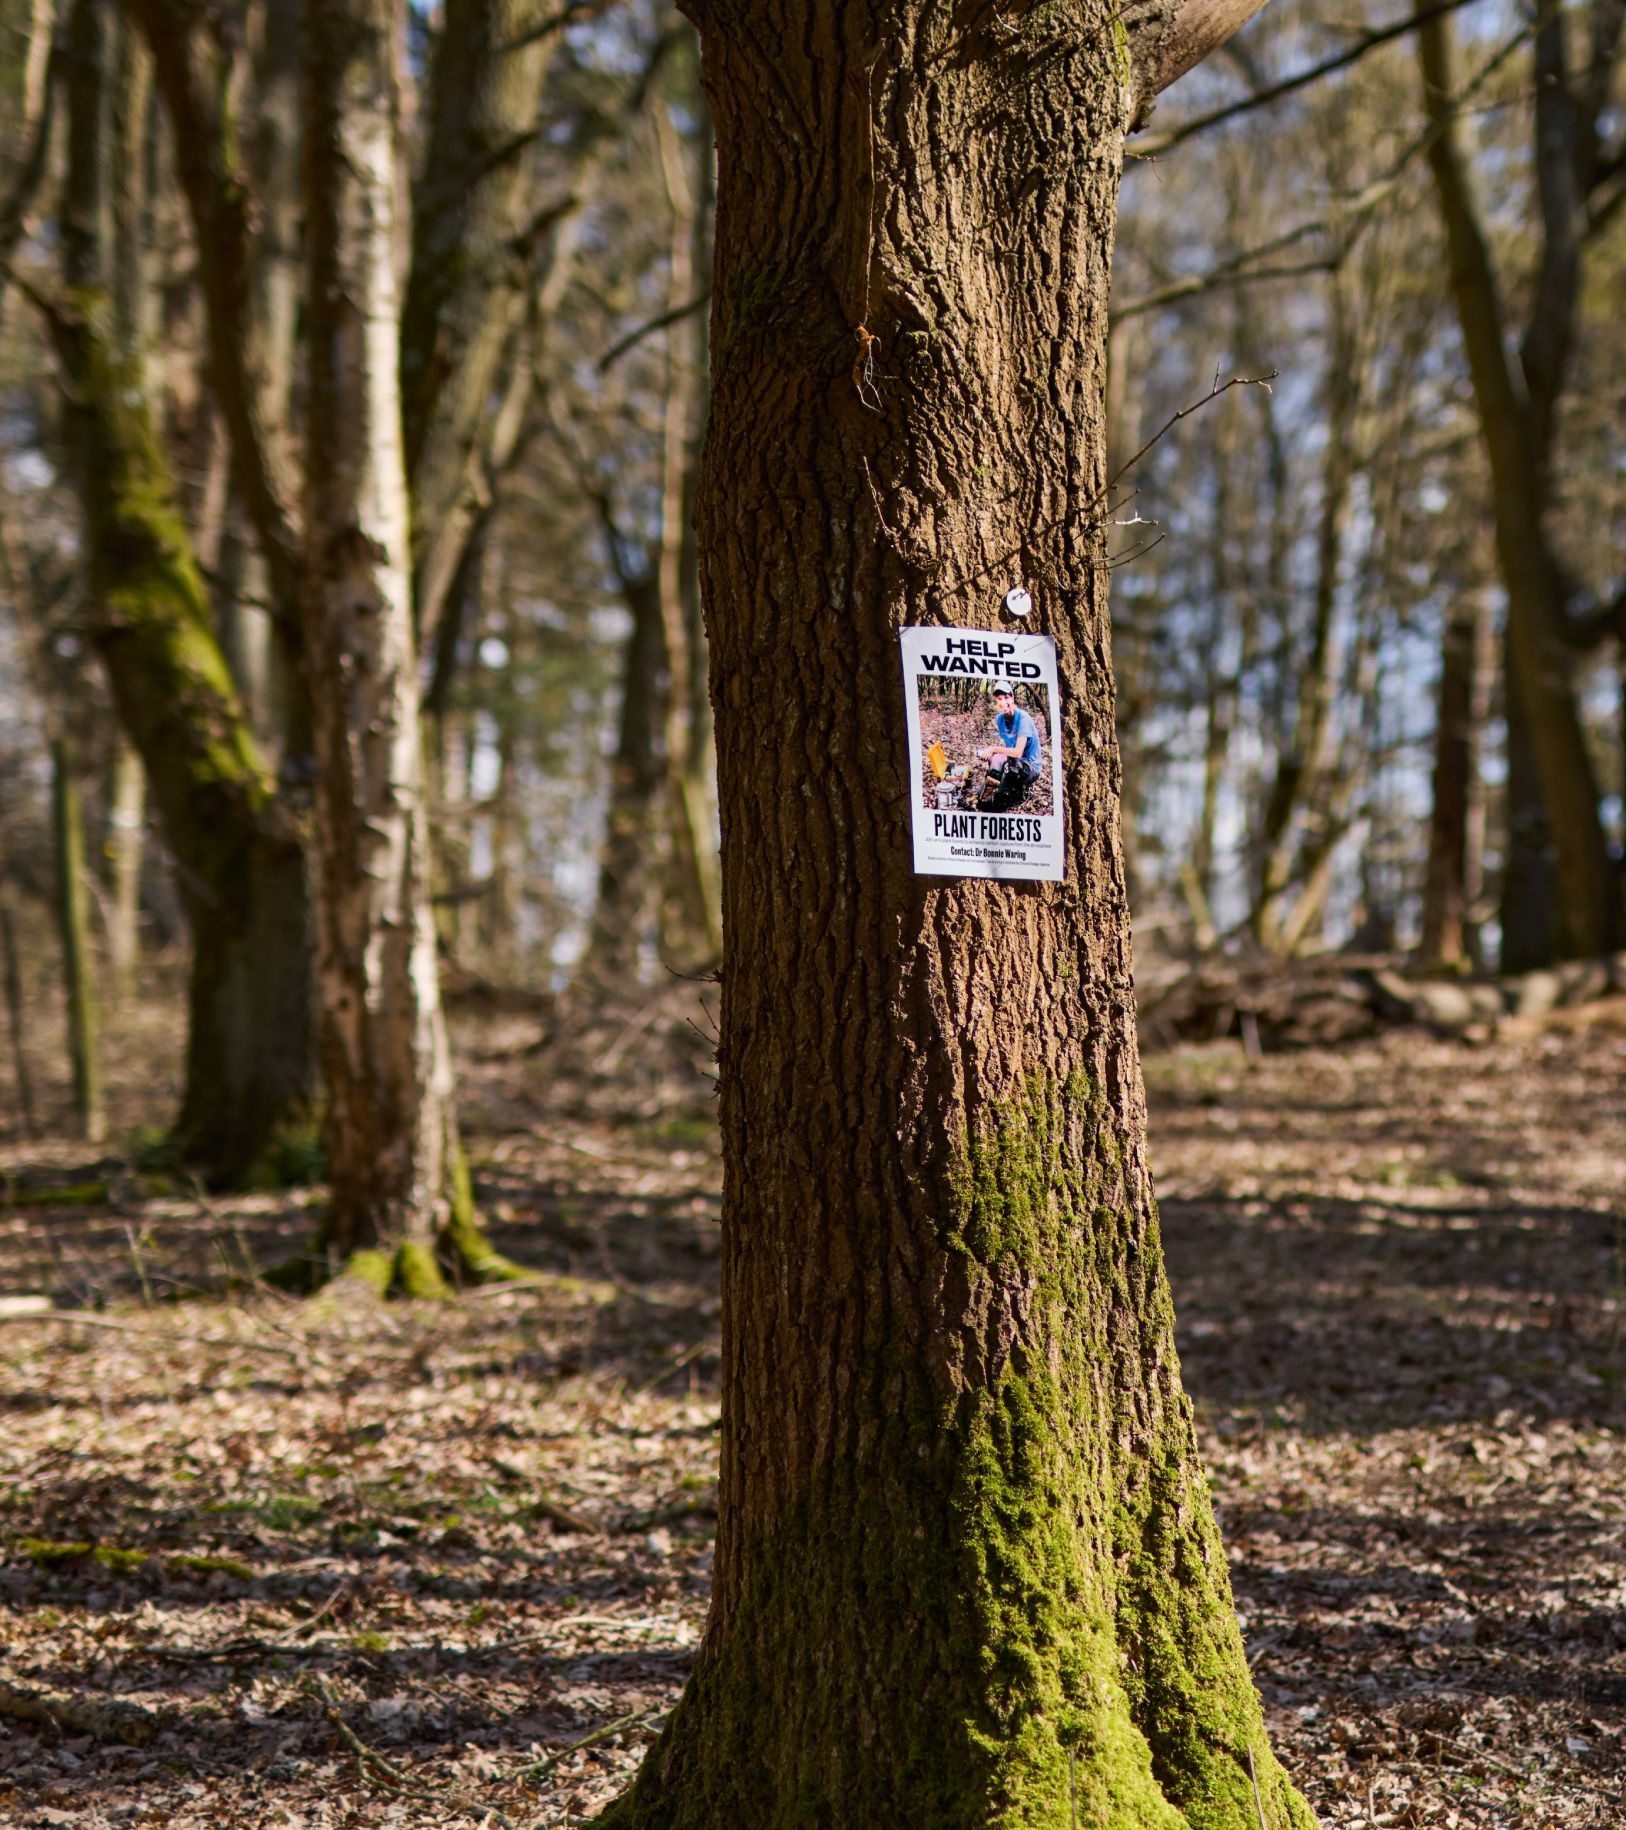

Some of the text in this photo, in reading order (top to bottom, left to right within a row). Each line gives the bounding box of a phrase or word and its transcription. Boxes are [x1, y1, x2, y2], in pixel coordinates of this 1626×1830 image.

[946, 638, 1015, 658] HELP
[920, 655, 1041, 678] WANTED
[935, 814, 1041, 842] PLANT FORESTS
[951, 846, 975, 856] Contact:
[976, 848, 983, 856] Dr
[984, 848, 1004, 858] Bonnie
[1005, 850, 1026, 861] Waring
